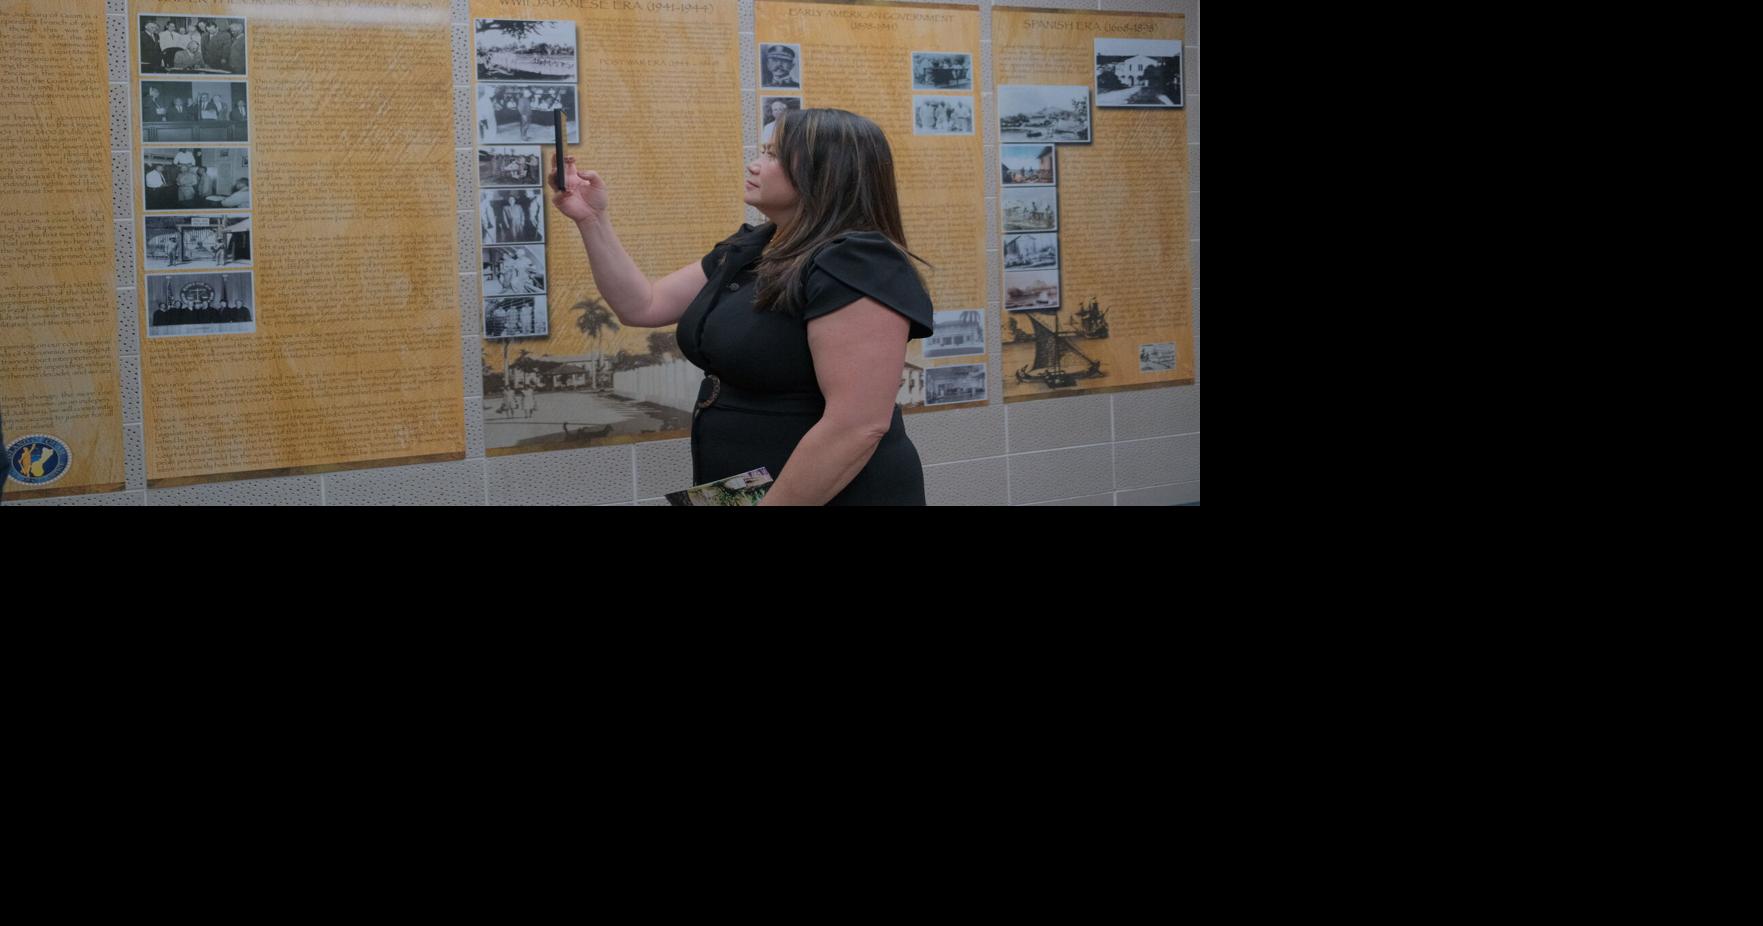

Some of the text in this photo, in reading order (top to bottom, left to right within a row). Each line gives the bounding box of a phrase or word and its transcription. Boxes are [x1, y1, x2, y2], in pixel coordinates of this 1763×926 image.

[534, 0, 610, 9] JAPANESE
[613, 0, 643, 10] ERA
[788, 7, 822, 17] EARLY
[882, 12, 954, 24] GOVERNMENT
[1024, 19, 1074, 31] SPANISH
[1076, 20, 1102, 32] ERA
